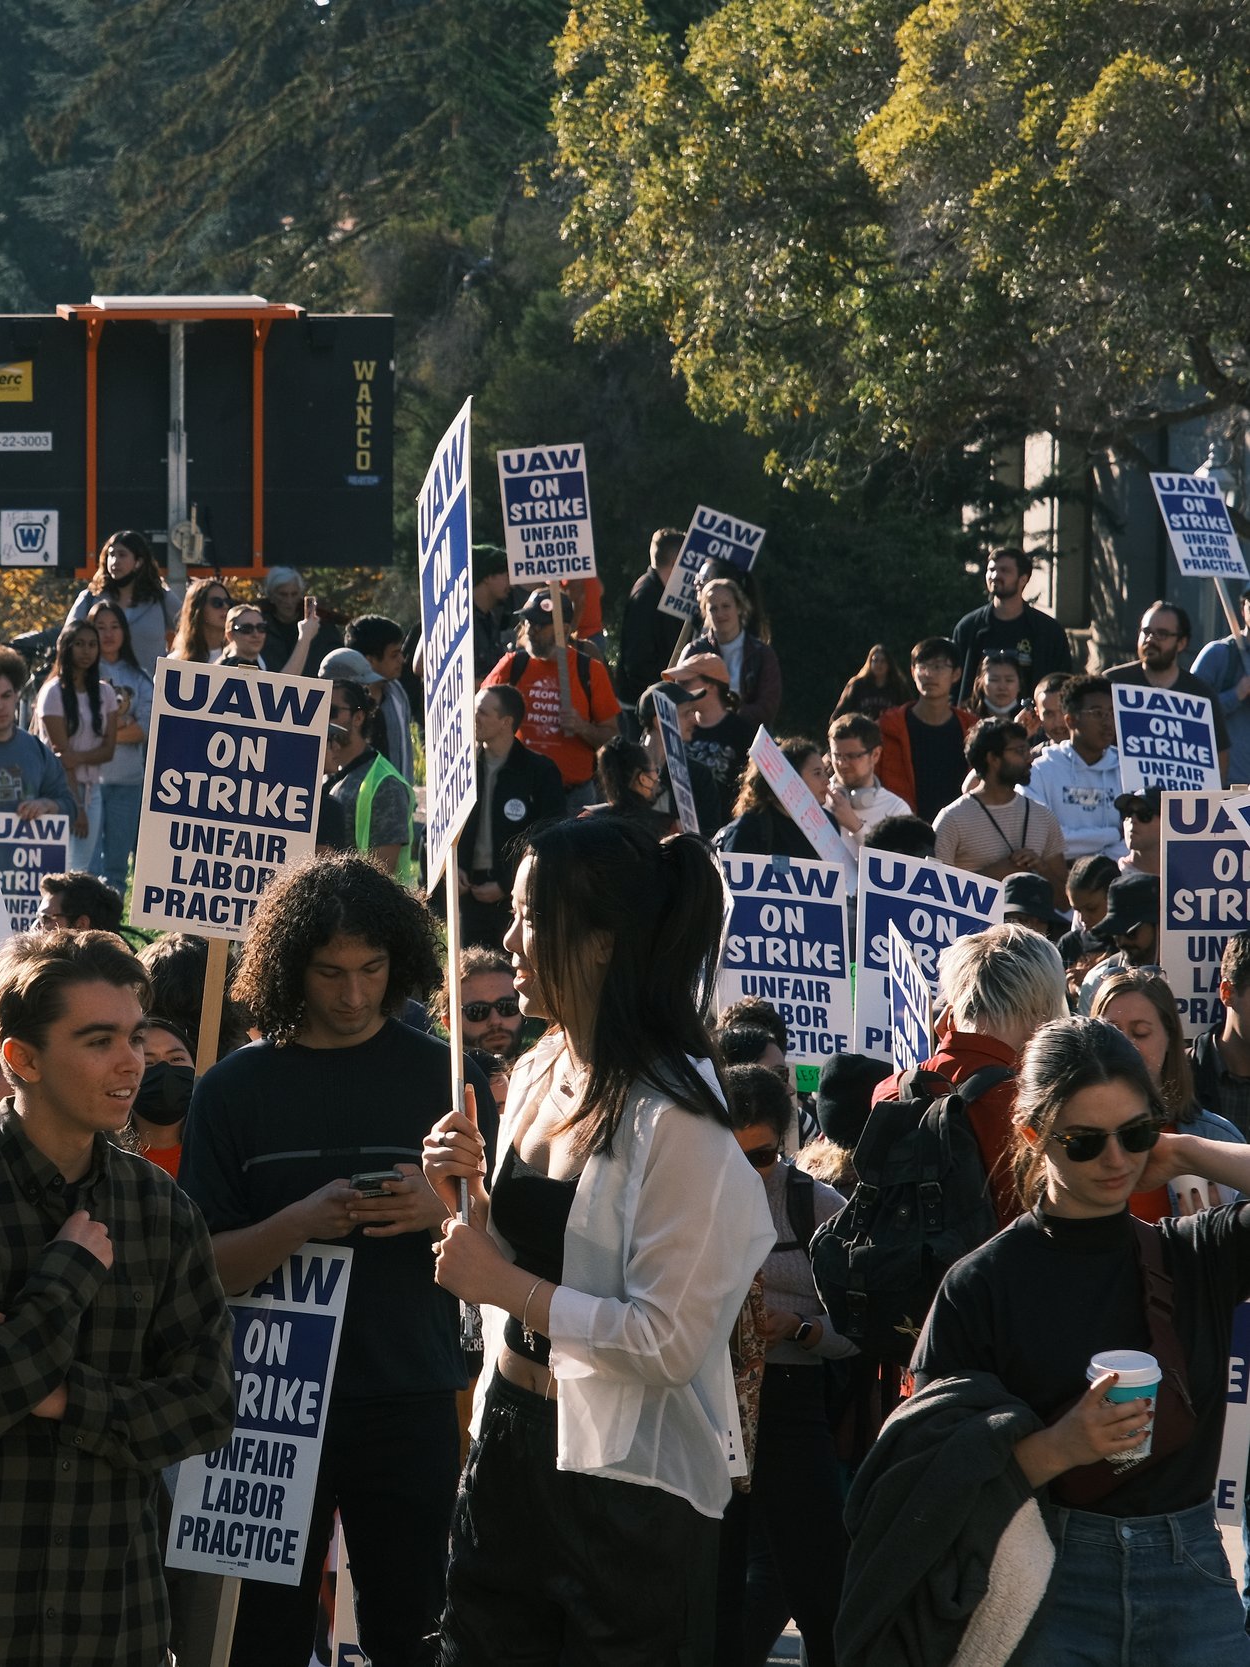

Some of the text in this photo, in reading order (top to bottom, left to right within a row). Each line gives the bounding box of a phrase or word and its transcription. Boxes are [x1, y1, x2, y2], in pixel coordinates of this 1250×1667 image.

[353, 360, 376, 470] WANCO
[503, 449, 581, 474] UAW
[421, 416, 467, 556] UAW
[530, 478, 559, 498] ON
[1155, 477, 1215, 495] UAW
[510, 497, 584, 521] STRIKE
[1182, 497, 1207, 513] ON
[520, 524, 578, 542] UNFAIR
[697, 511, 761, 546] UAW
[1170, 513, 1229, 532] STRIKE
[525, 541, 577, 559] LABOR
[707, 540, 734, 559] ON
[1182, 533, 1229, 547] UNFAIR
[1189, 546, 1231, 559] LABOR
[433, 526, 451, 606] ON
[514, 556, 591, 576] PRACTICE
[1182, 559, 1245, 574] PRACTICE
[426, 567, 469, 695] STRIKE
[164, 669, 325, 727] UAW
[431, 654, 464, 752] UNFAIR
[529, 689, 560, 700] PEOPL
[533, 702, 560, 712] OVER
[1118, 689, 1206, 719] UAW
[1149, 717, 1184, 739] ON
[206, 731, 268, 773] ON
[434, 708, 462, 800] LABOR
[1126, 735, 1210, 764] STRIKE
[1138, 760, 1204, 782] UNFAIR
[156, 768, 309, 822] STRIKE
[430, 743, 472, 866] PRACTICE
[1168, 799, 1238, 834] UA
[13, 847, 42, 868] ON
[169, 821, 287, 864] UNFAIR
[723, 860, 840, 899] UAW
[868, 857, 999, 915] UAW
[143, 886, 257, 926] PRACT
[759, 904, 805, 934] ON
[1171, 888, 1250, 922] STR
[909, 908, 958, 944] ON
[726, 934, 841, 972] STRIKE
[741, 974, 831, 1004] UNFAIR
[891, 935, 927, 1025] UAW
[770, 1001, 828, 1029] BOR
[903, 1005, 919, 1052] ON
[786, 1031, 848, 1055] CTICE
[251, 1254, 345, 1306] AW
[243, 1319, 292, 1366] ON
[235, 1371, 319, 1425] RIKE
[201, 1475, 286, 1521] LABOR
[176, 1514, 299, 1566] PRACTICE
